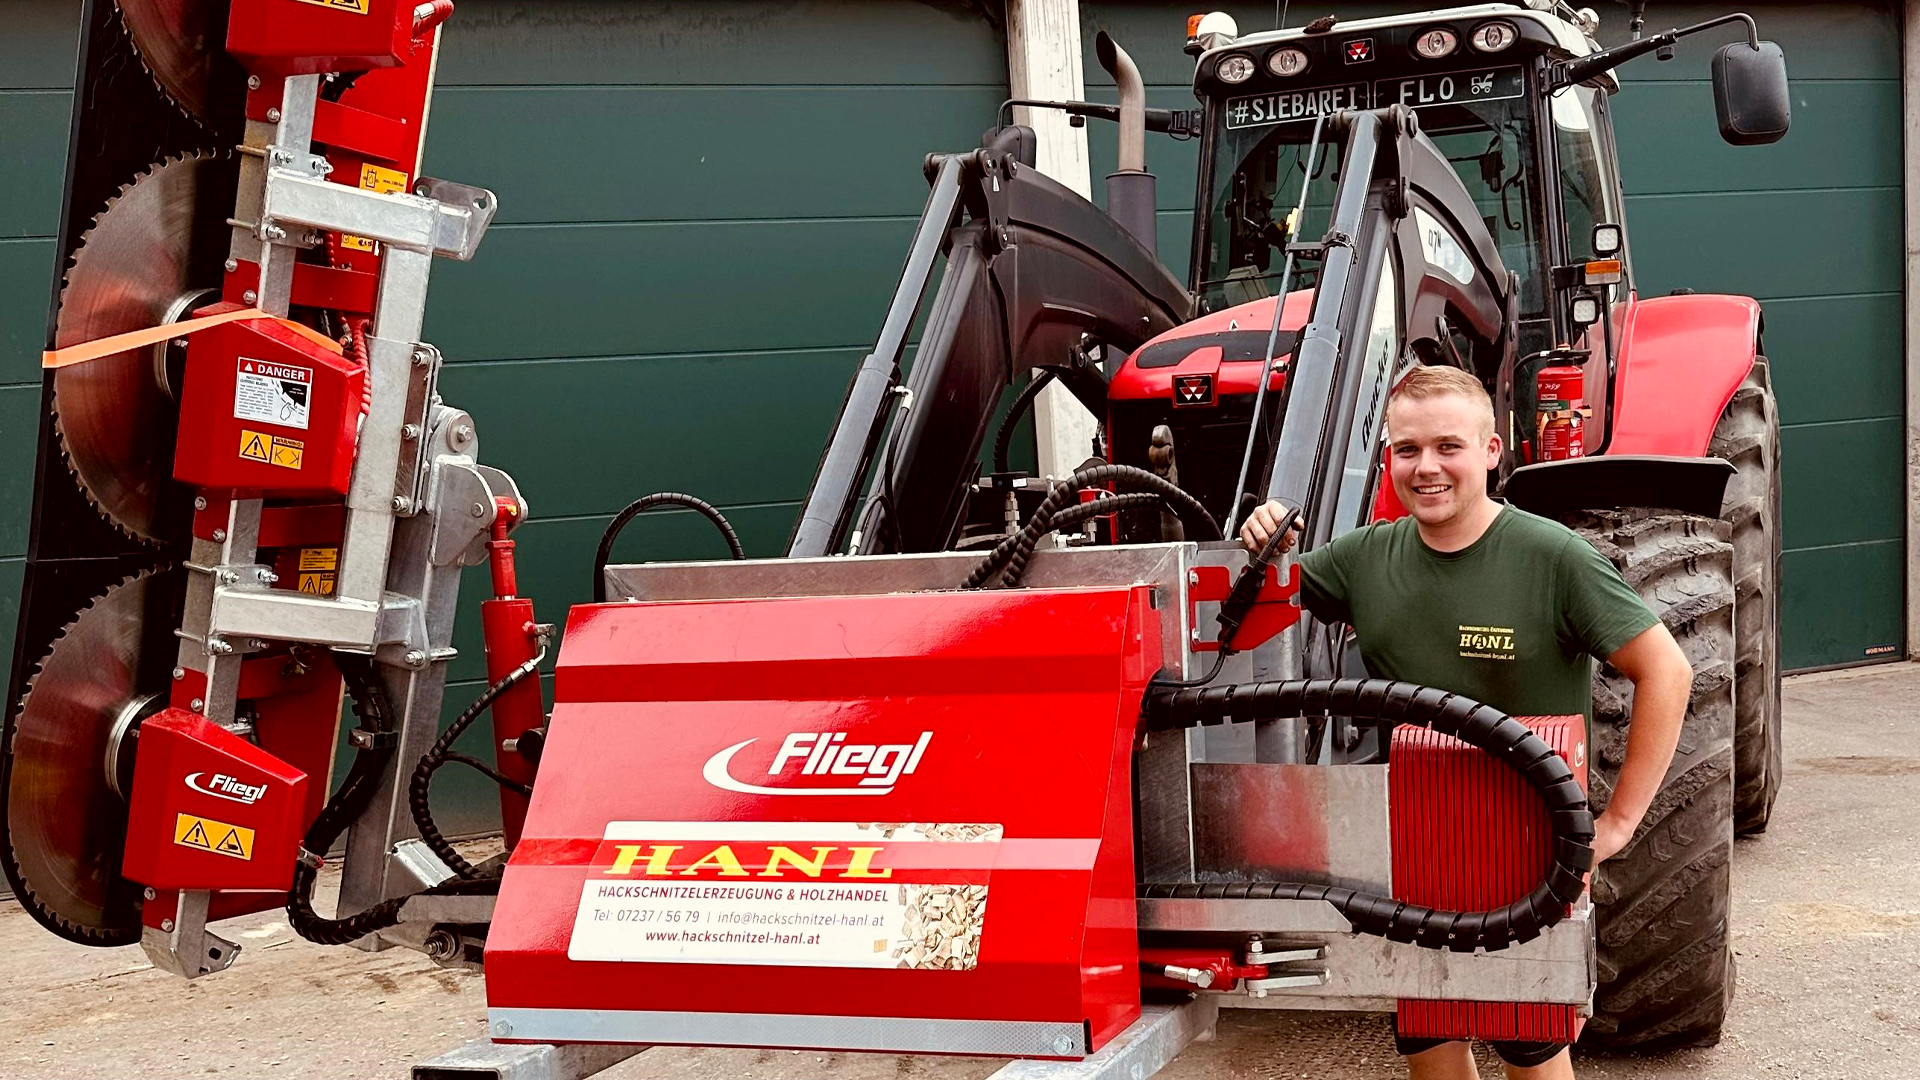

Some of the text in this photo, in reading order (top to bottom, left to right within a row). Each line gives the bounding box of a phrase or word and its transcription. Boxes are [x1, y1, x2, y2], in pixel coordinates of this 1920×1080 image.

[1234, 77, 1455, 124] #SIEBAREI FLO
[258, 364, 305, 380] DANGER
[1460, 634, 1514, 649] HANL
[767, 731, 933, 785] Fliegl
[208, 774, 268, 802] Fliegl
[603, 845, 892, 878] HANL
[598, 885, 889, 902] HACKSCHNITZELERZEUGUNG & HOLZHANDEL
[617, 909, 654, 922] 07237
[666, 910, 681, 923] 56
[685, 910, 700, 923] 79
[717, 911, 884, 927] info@hackschnitzel-hanl.at
[645, 930, 820, 945] www.hackschnitzel-hanl.at
